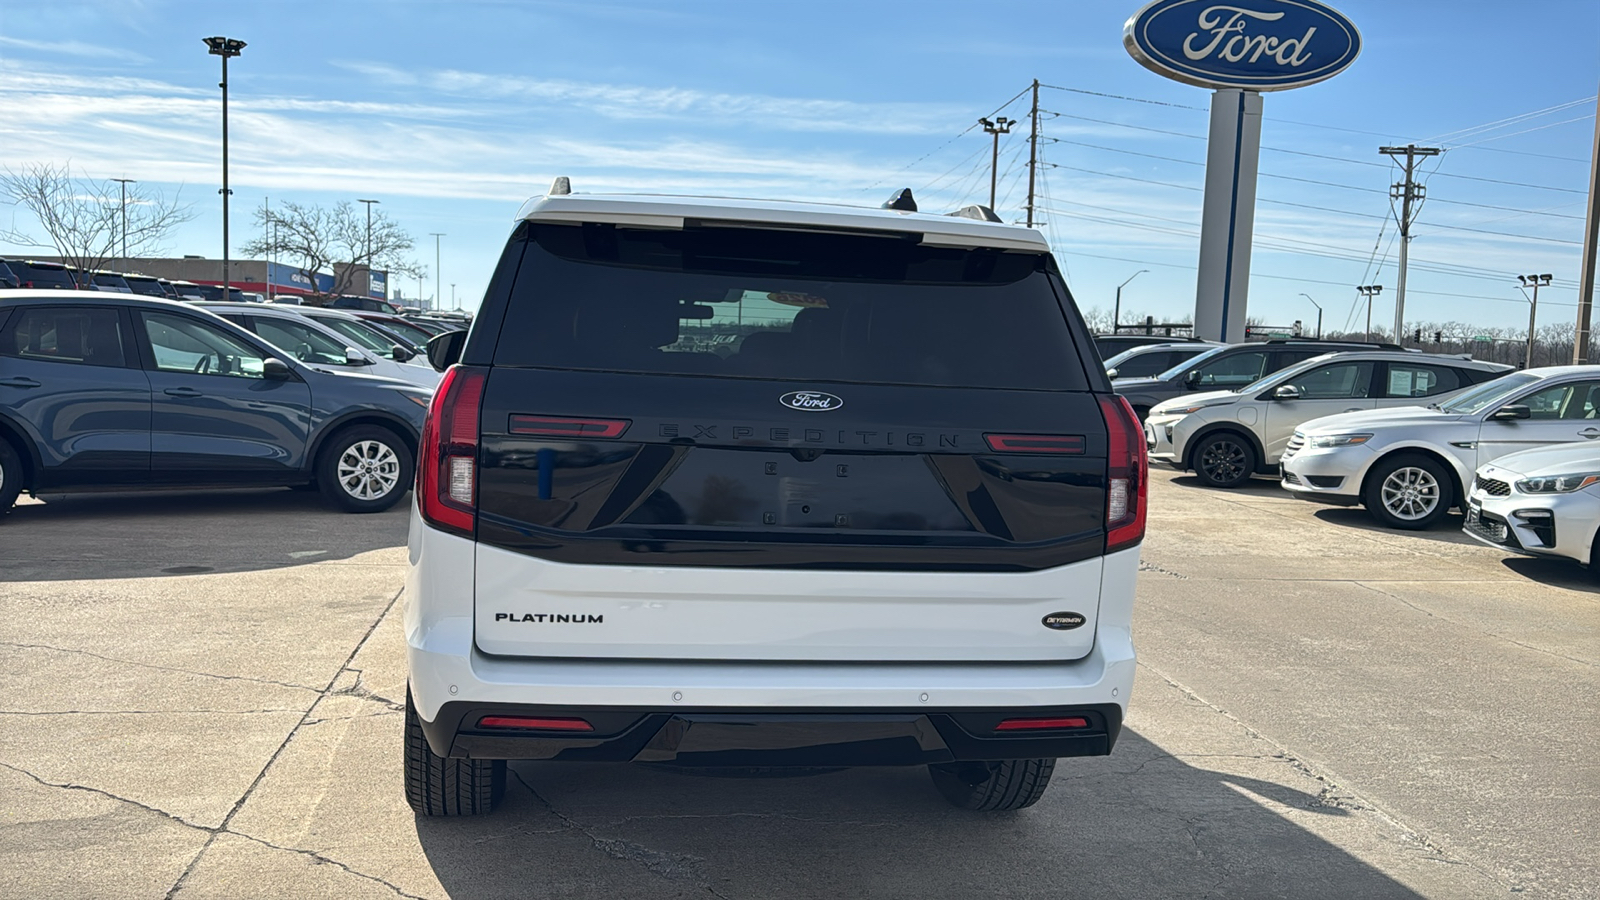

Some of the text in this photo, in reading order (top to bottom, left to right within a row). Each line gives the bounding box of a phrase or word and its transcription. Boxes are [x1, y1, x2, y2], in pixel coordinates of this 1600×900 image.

[1183, 5, 1317, 67] Ford
[792, 393, 831, 408] Ford
[658, 423, 959, 447] EXPEDITION
[495, 612, 604, 624] PLATINUM
